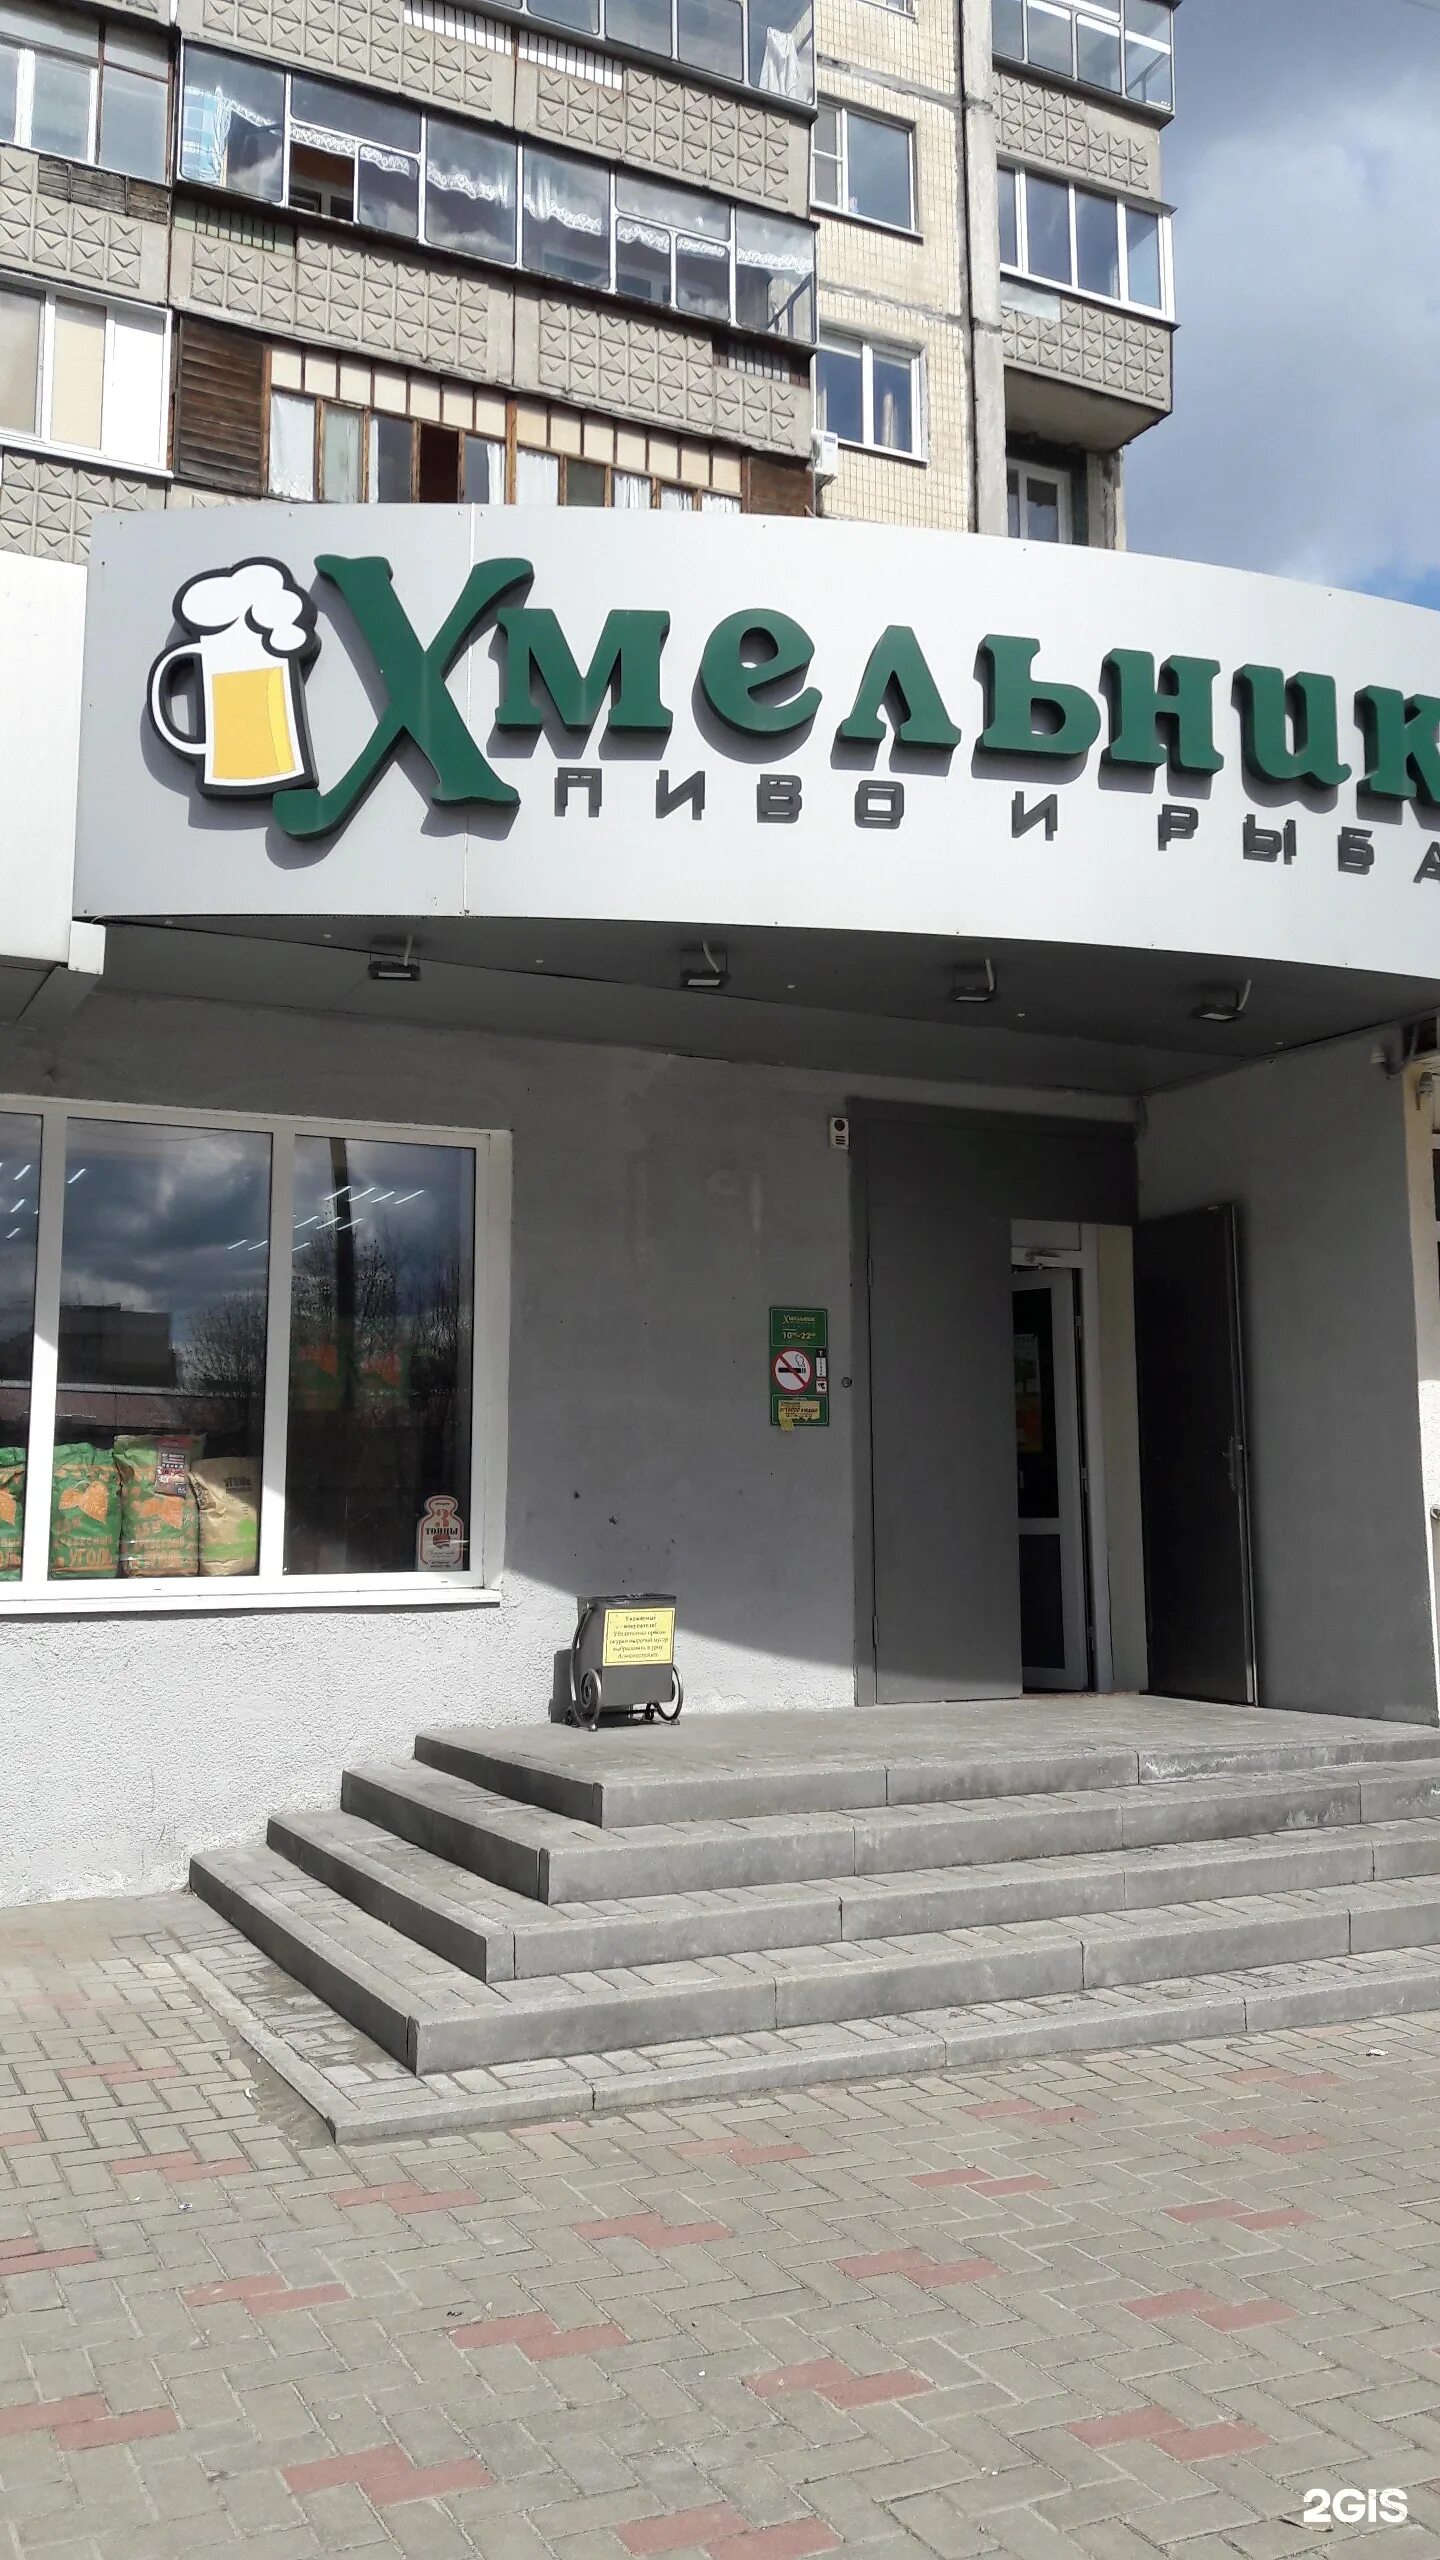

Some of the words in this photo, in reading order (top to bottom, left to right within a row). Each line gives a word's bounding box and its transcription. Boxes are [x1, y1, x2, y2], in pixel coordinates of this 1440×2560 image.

[273, 554, 1440, 839] Хмельник
[554, 766, 905, 829] ПИВО
[1012, 790, 1058, 842] И
[1158, 803, 1440, 884] РЫБА
